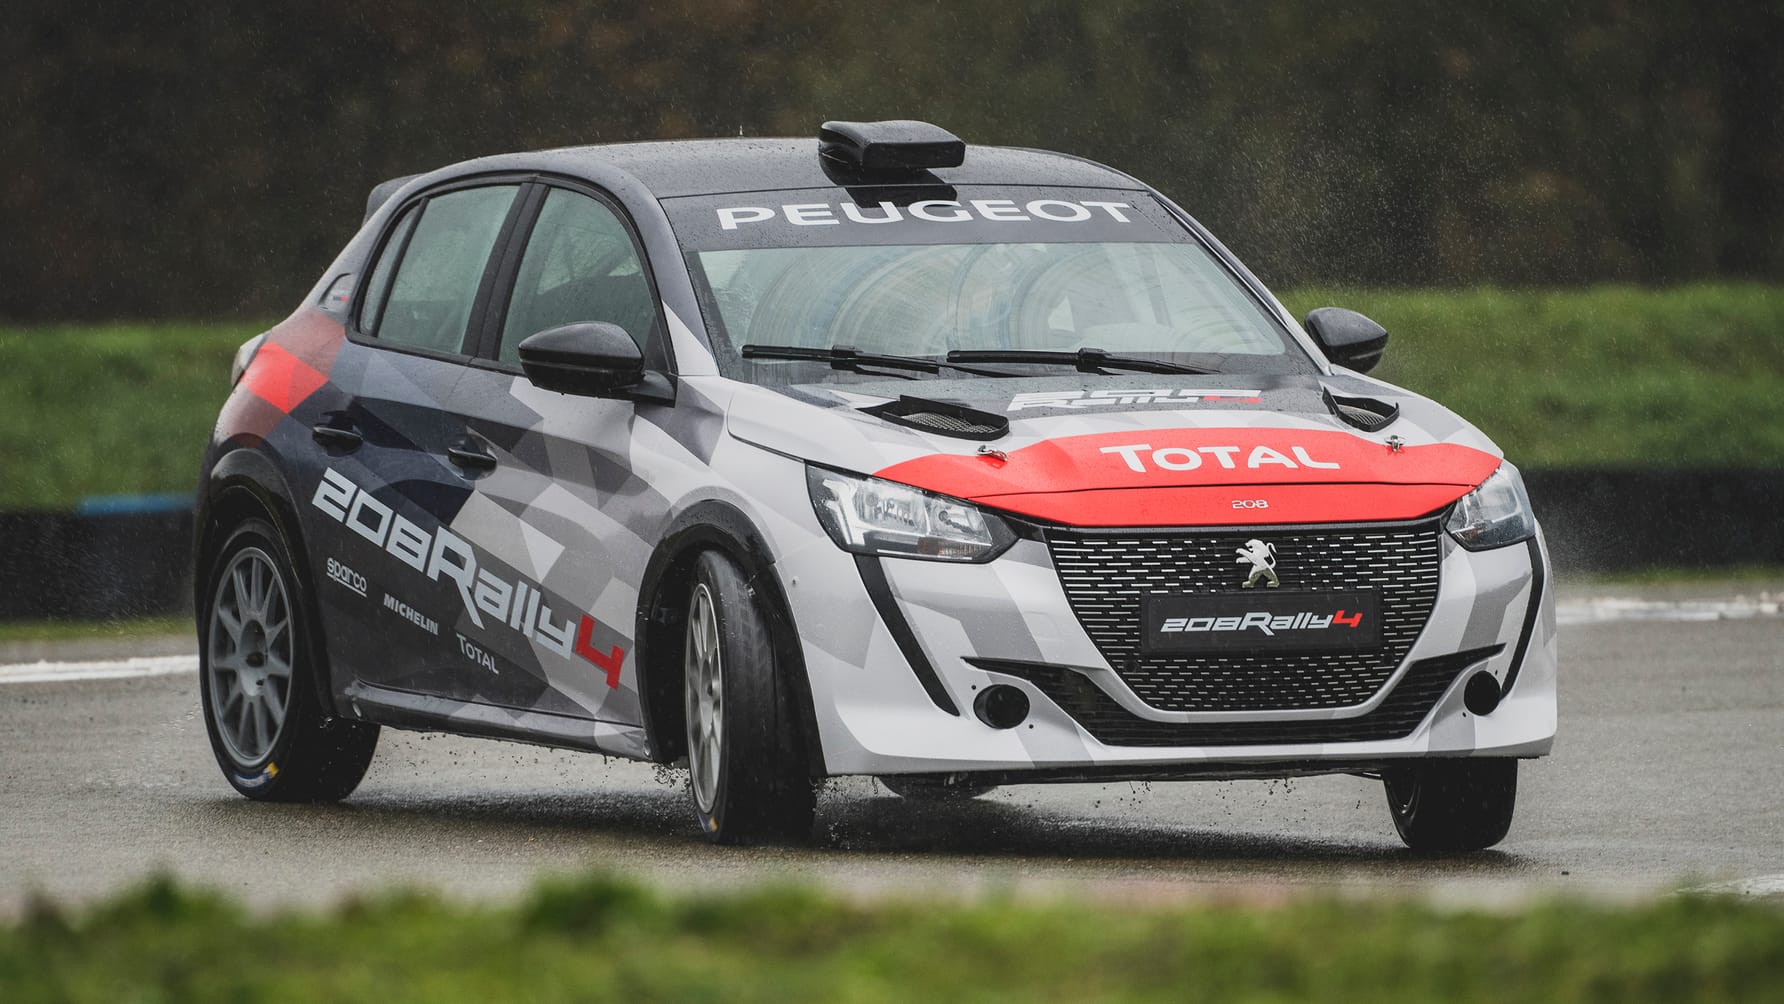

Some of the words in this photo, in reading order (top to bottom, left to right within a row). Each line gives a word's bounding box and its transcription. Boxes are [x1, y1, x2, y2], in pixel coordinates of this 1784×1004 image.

[716, 200, 1131, 231] PEUGEOT
[1100, 443, 1341, 473] TOTAL
[1231, 499, 1269, 509] 208
[326, 557, 367, 594] sparco
[383, 593, 439, 636] MICHELIN
[456, 632, 499, 675] TOTAL
